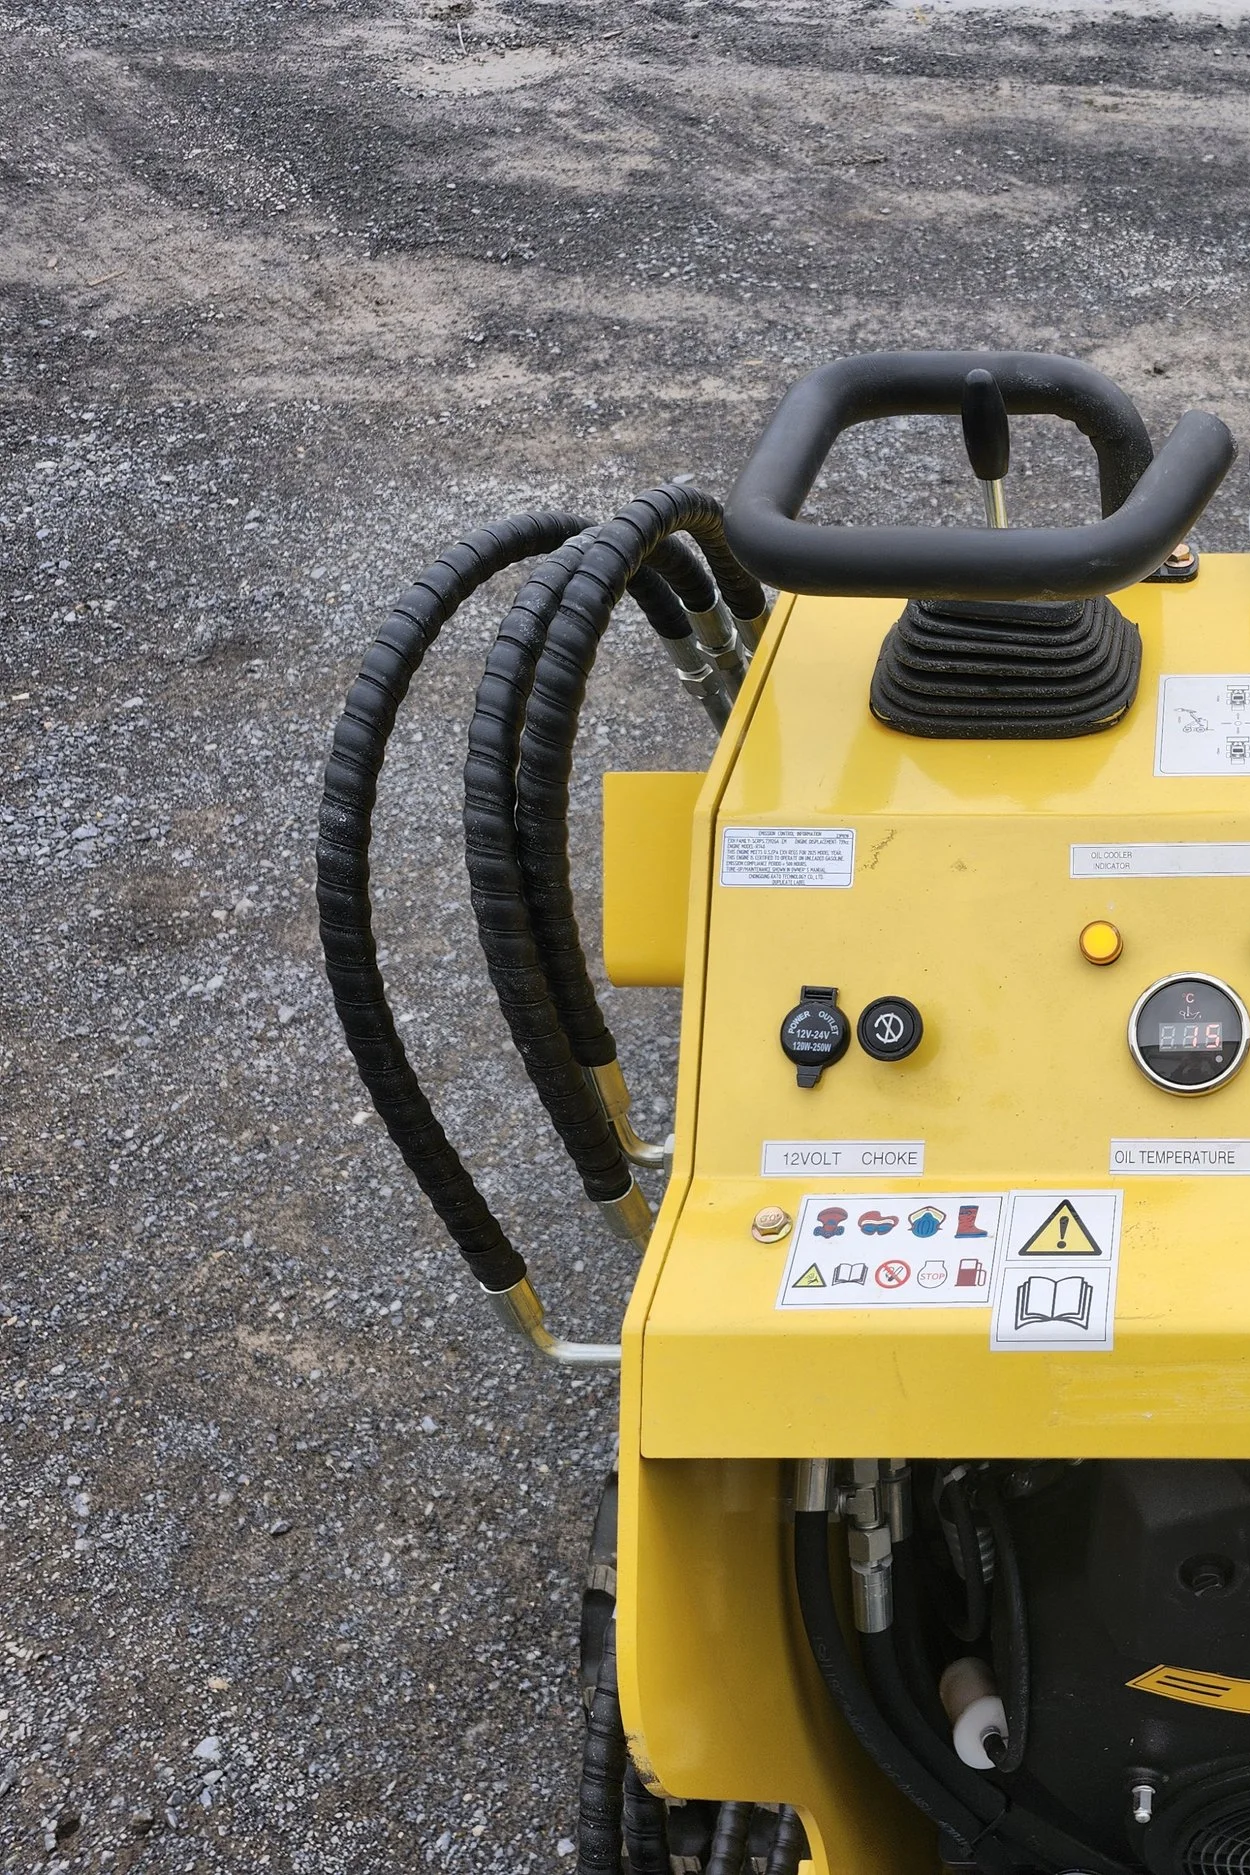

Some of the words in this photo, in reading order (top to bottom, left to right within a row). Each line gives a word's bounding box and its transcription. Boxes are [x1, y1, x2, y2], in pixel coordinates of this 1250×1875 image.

[1091, 851, 1102, 859] OIL
[1103, 851, 1133, 859] COOLER
[1093, 862, 1131, 870] INDICATOR
[788, 1010, 811, 1034] POWER
[818, 1010, 839, 1036] OUTLET
[796, 1029, 830, 1040] 12V-24V
[792, 1042, 832, 1053] 120W-250W
[783, 1152, 842, 1166] 12VOLT
[861, 1151, 918, 1166] CHOKE
[1114, 1150, 1136, 1165] OIL
[1139, 1150, 1236, 1165] TEMPERATURE
[919, 1272, 946, 1281] STOP
